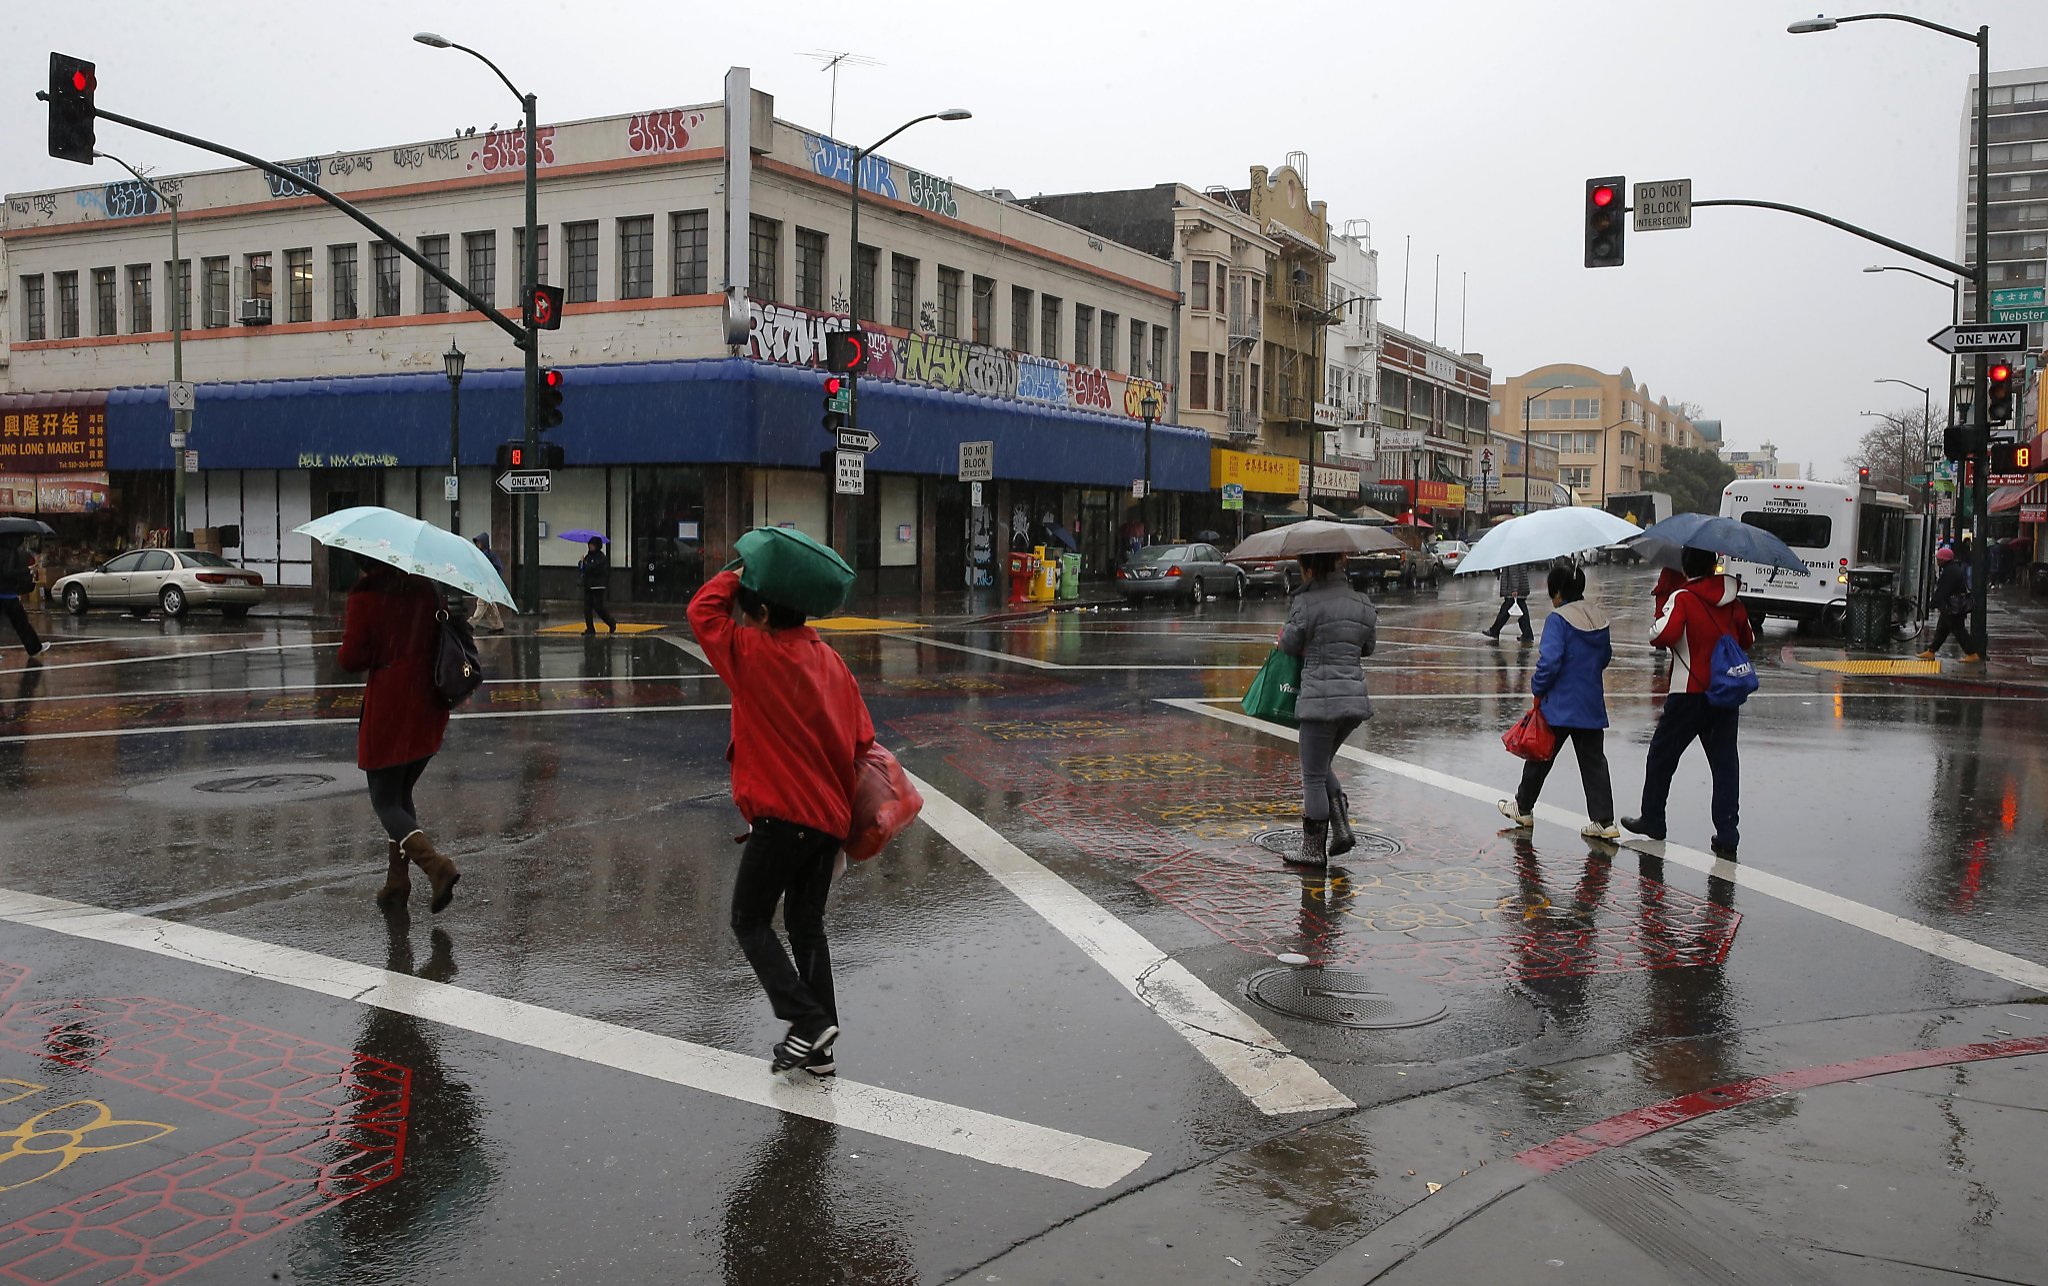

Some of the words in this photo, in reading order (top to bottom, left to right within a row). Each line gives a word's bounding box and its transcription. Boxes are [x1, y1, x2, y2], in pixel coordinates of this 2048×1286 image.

[1640, 187, 1656, 199] DO
[1662, 184, 1683, 197] NOT
[1643, 201, 1680, 215] BLOCK
[1636, 215, 1688, 228] INTERSECTION
[1999, 310, 2045, 321] Webster
[1956, 333, 1983, 345] ONE
[1988, 332, 2016, 344] WAY
[841, 434, 854, 444] ONE
[856, 436, 868, 446] WAY
[20, 442, 44, 455] LONG
[47, 441, 86, 455] MARKET
[963, 447, 973, 456] DO
[975, 445, 988, 455] NOT
[839, 458, 847, 467] NO
[848, 459, 862, 468] TURN
[964, 458, 986, 468] BLOCK
[2017, 448, 2029, 467] 18
[840, 468, 848, 477] ON
[849, 469, 860, 478] RED
[511, 477, 526, 487] ONE
[528, 476, 544, 486] WAY
[838, 478, 862, 489] 7am-7pm
[1762, 507, 1809, 515] 510-777-9700
